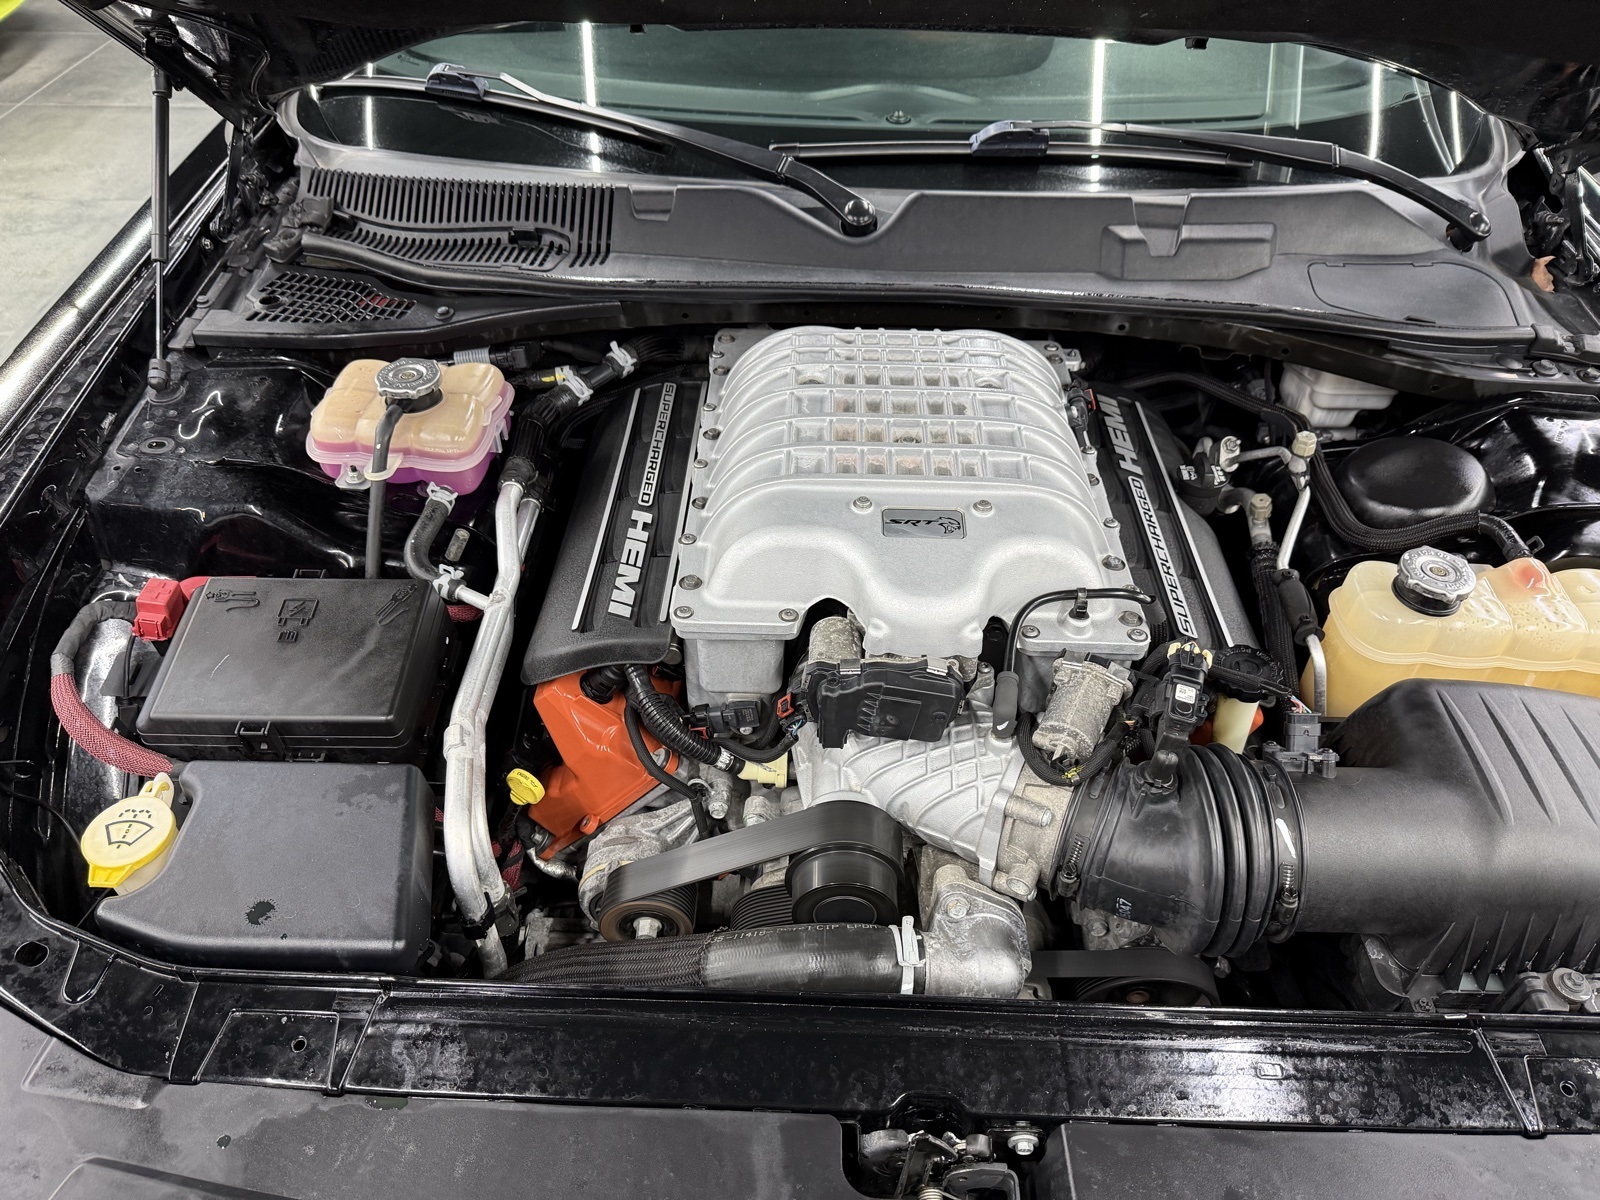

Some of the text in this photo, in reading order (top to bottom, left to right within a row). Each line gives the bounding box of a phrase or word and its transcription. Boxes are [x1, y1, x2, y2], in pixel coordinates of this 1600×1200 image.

[608, 384, 674, 618] SUPERCHARGED HEMI
[885, 518, 939, 527] SRT
[1097, 394, 1195, 636] SUPERCHARGED HEMI
